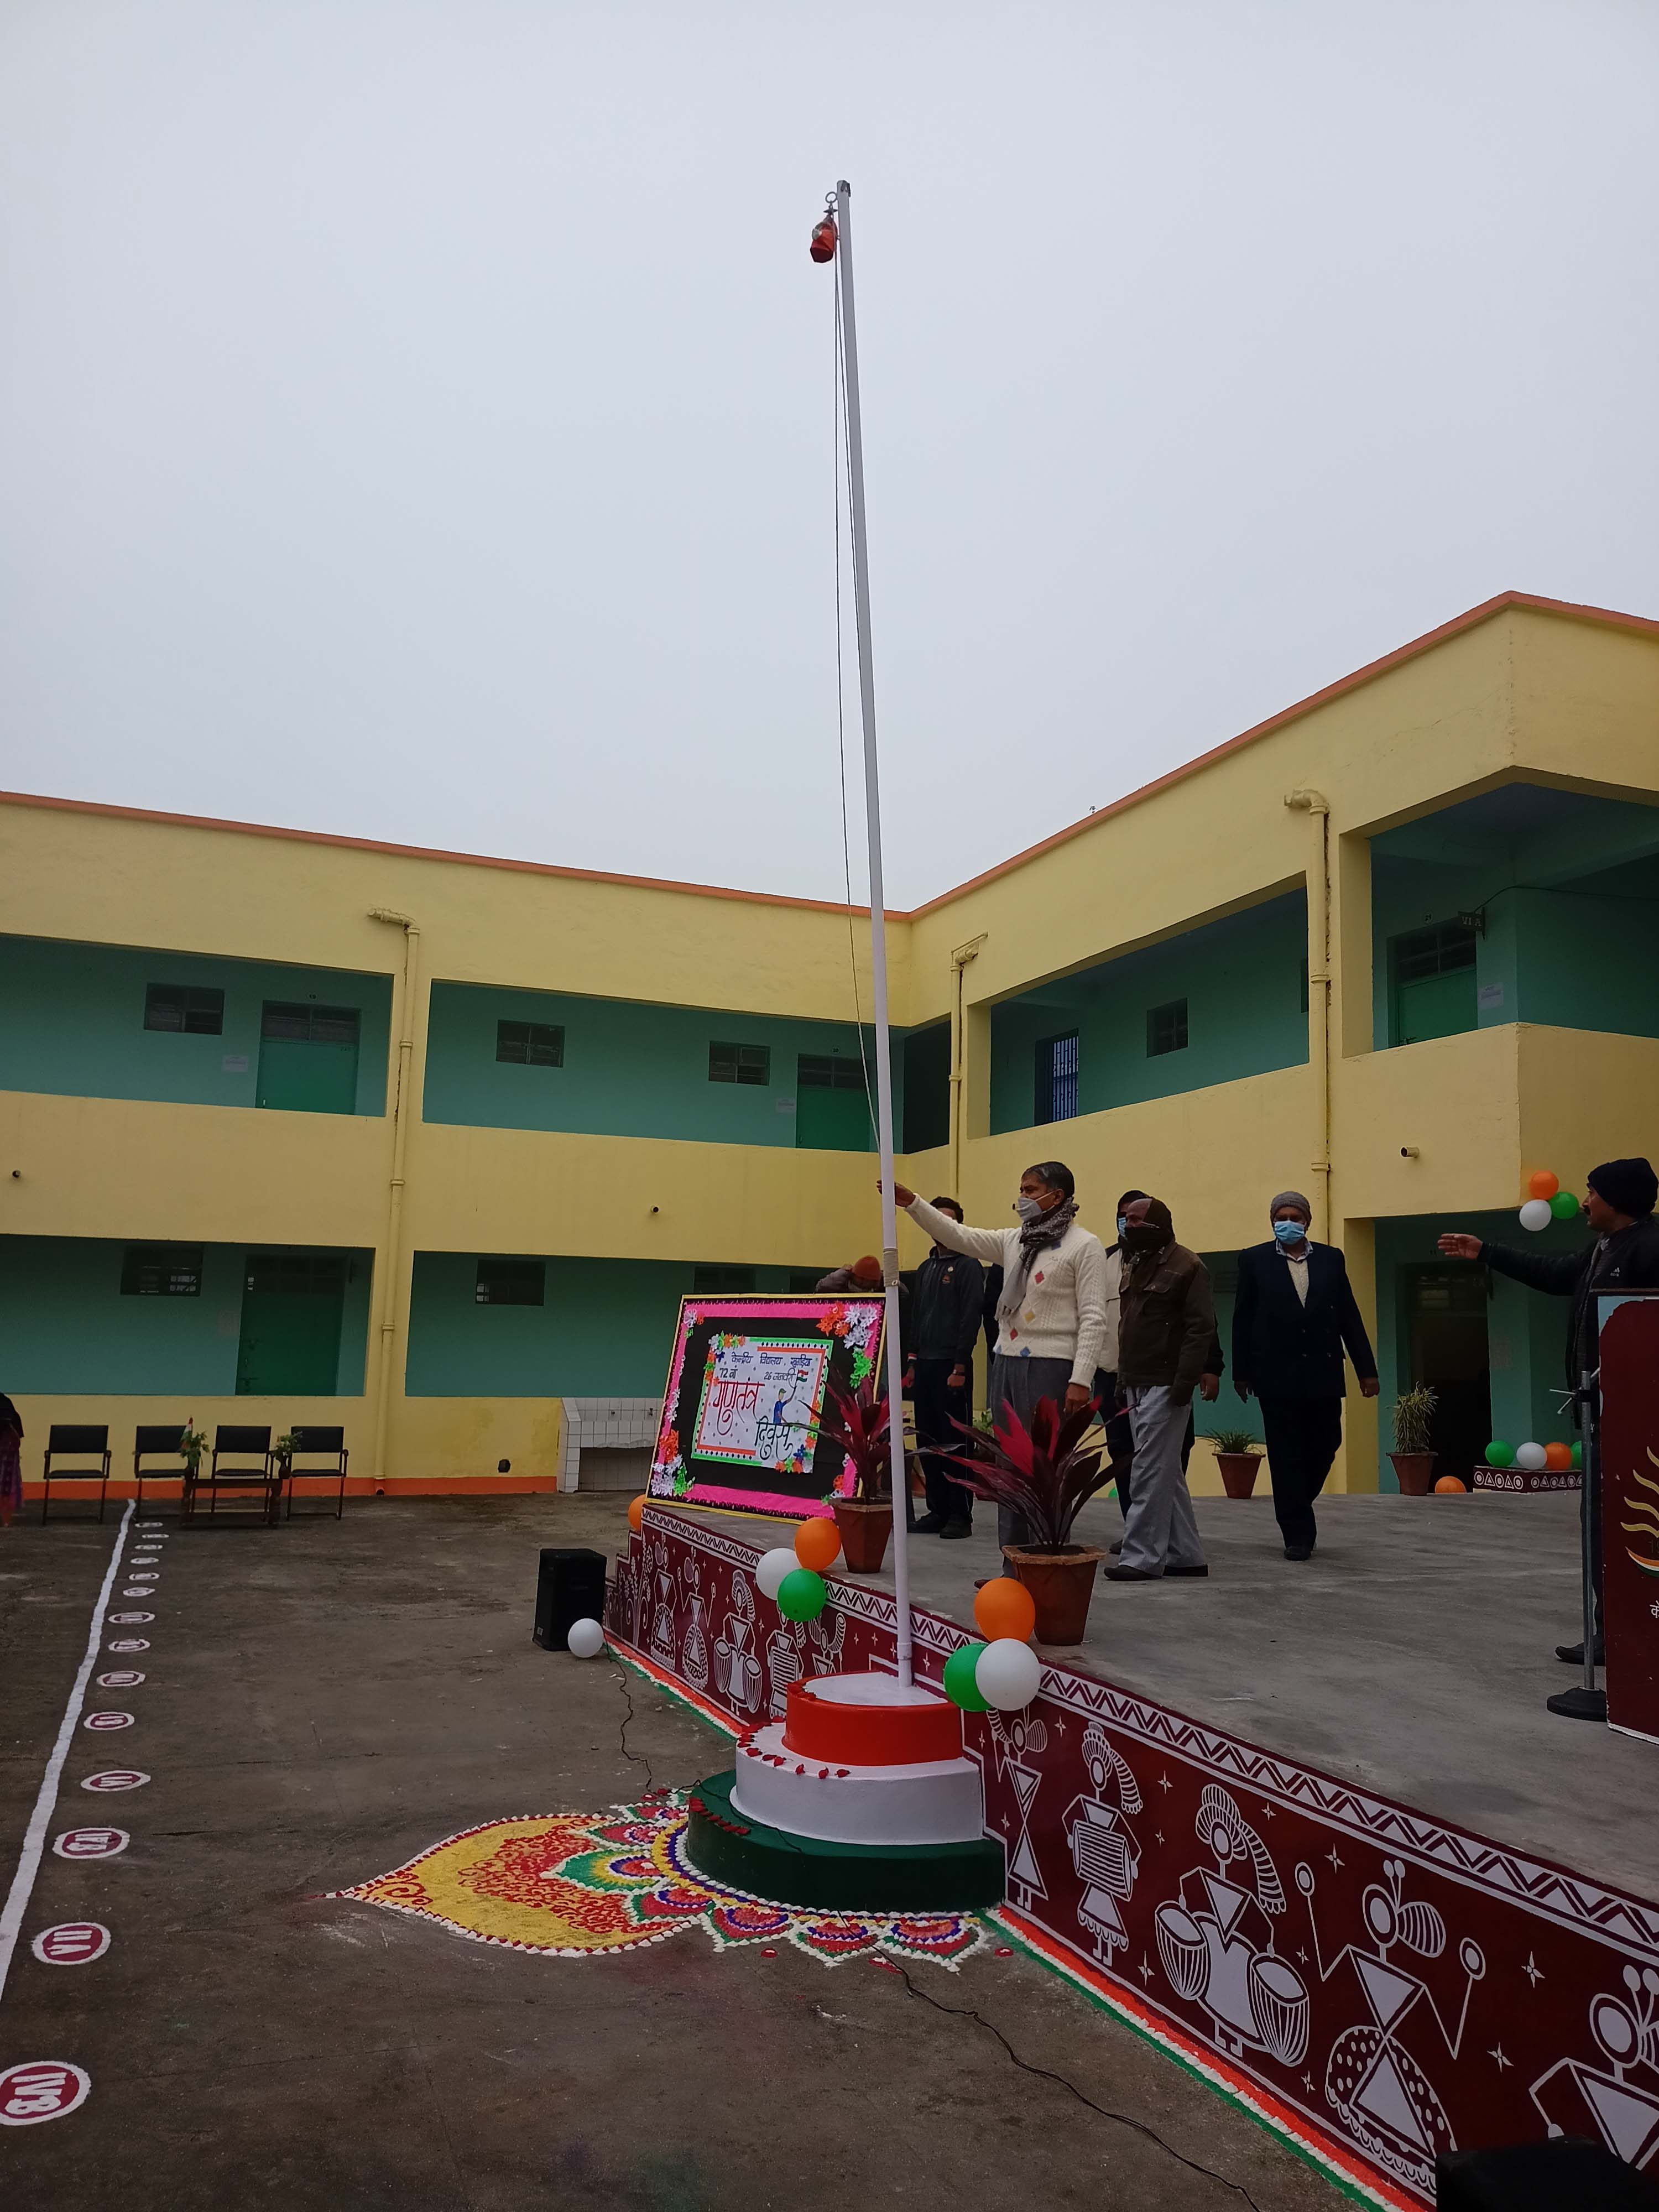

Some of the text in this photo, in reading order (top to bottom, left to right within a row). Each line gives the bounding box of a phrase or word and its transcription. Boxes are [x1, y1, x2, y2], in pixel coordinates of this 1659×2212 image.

[719, 1368, 728, 1378] 72
[764, 1371, 773, 1380] 26
[713, 1376, 765, 1436] गणतंत्र
[754, 1416, 794, 1462] दिवस
